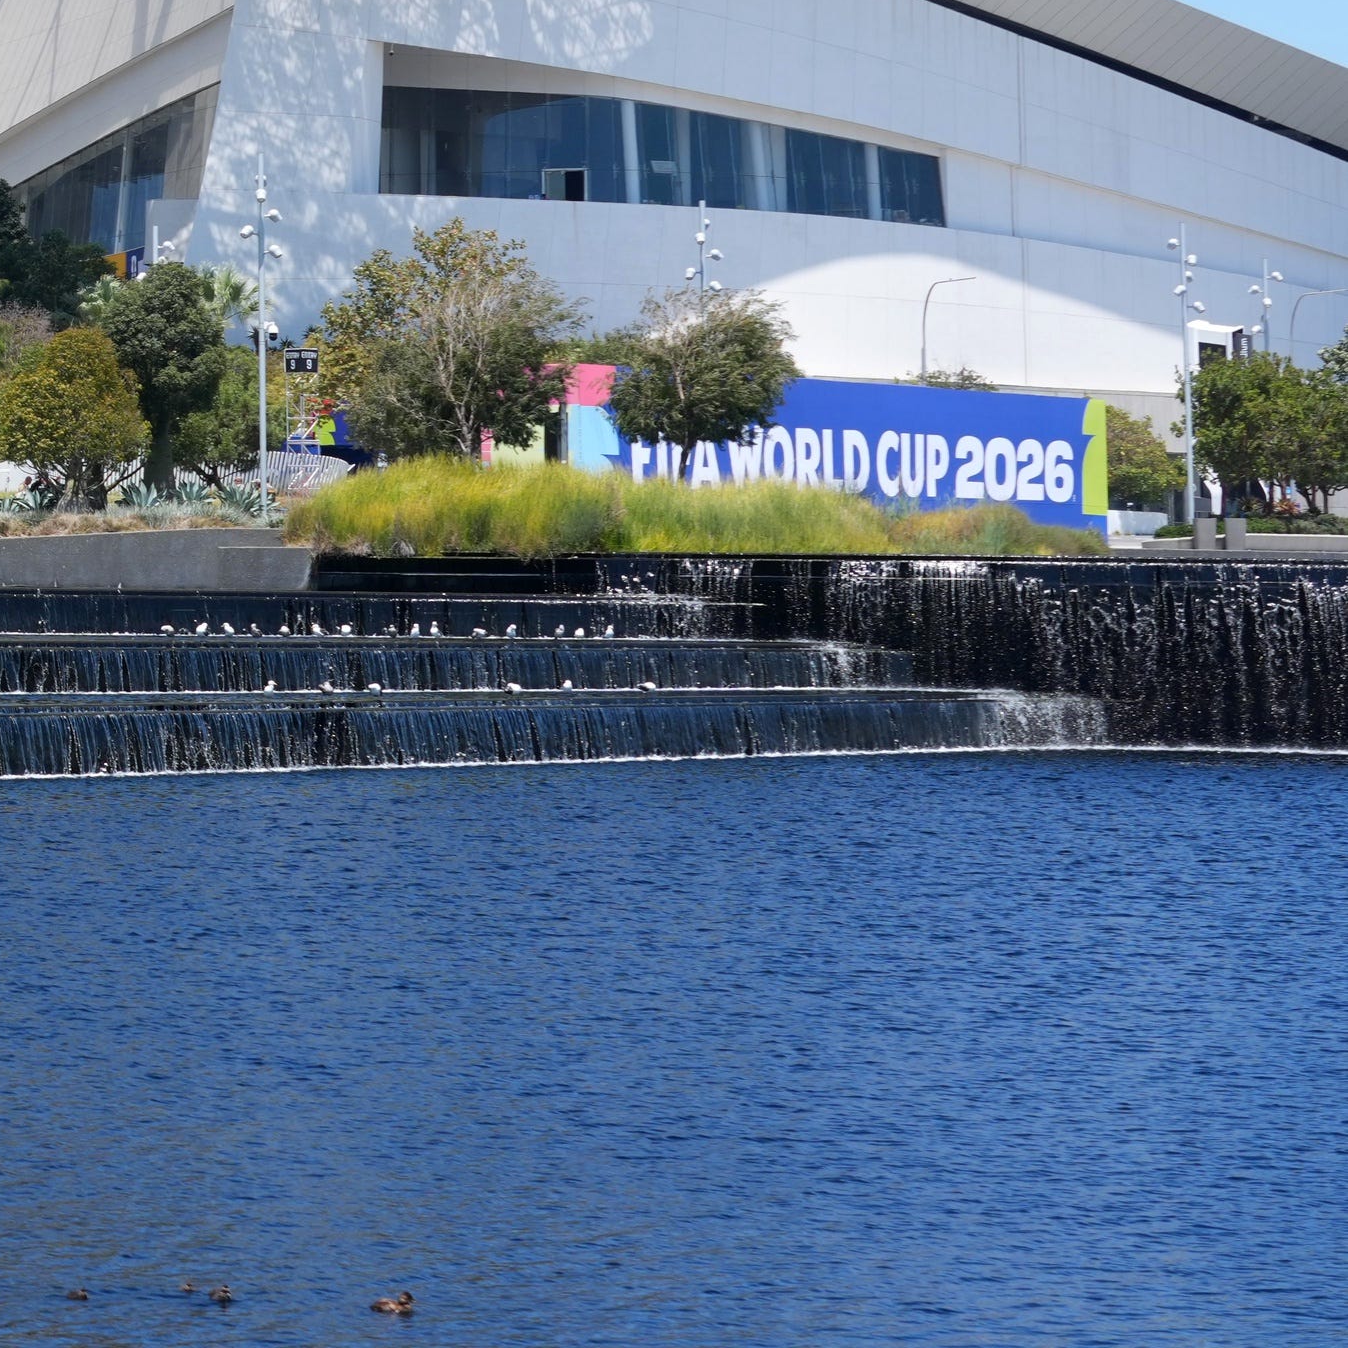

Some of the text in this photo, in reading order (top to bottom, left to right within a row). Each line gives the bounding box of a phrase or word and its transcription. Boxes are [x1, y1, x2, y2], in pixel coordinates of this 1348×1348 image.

[290, 359, 296, 370] 9
[306, 359, 312, 369] 9
[728, 425, 871, 494] WORLD
[877, 430, 950, 499] CUP
[954, 435, 1075, 503] 2026
